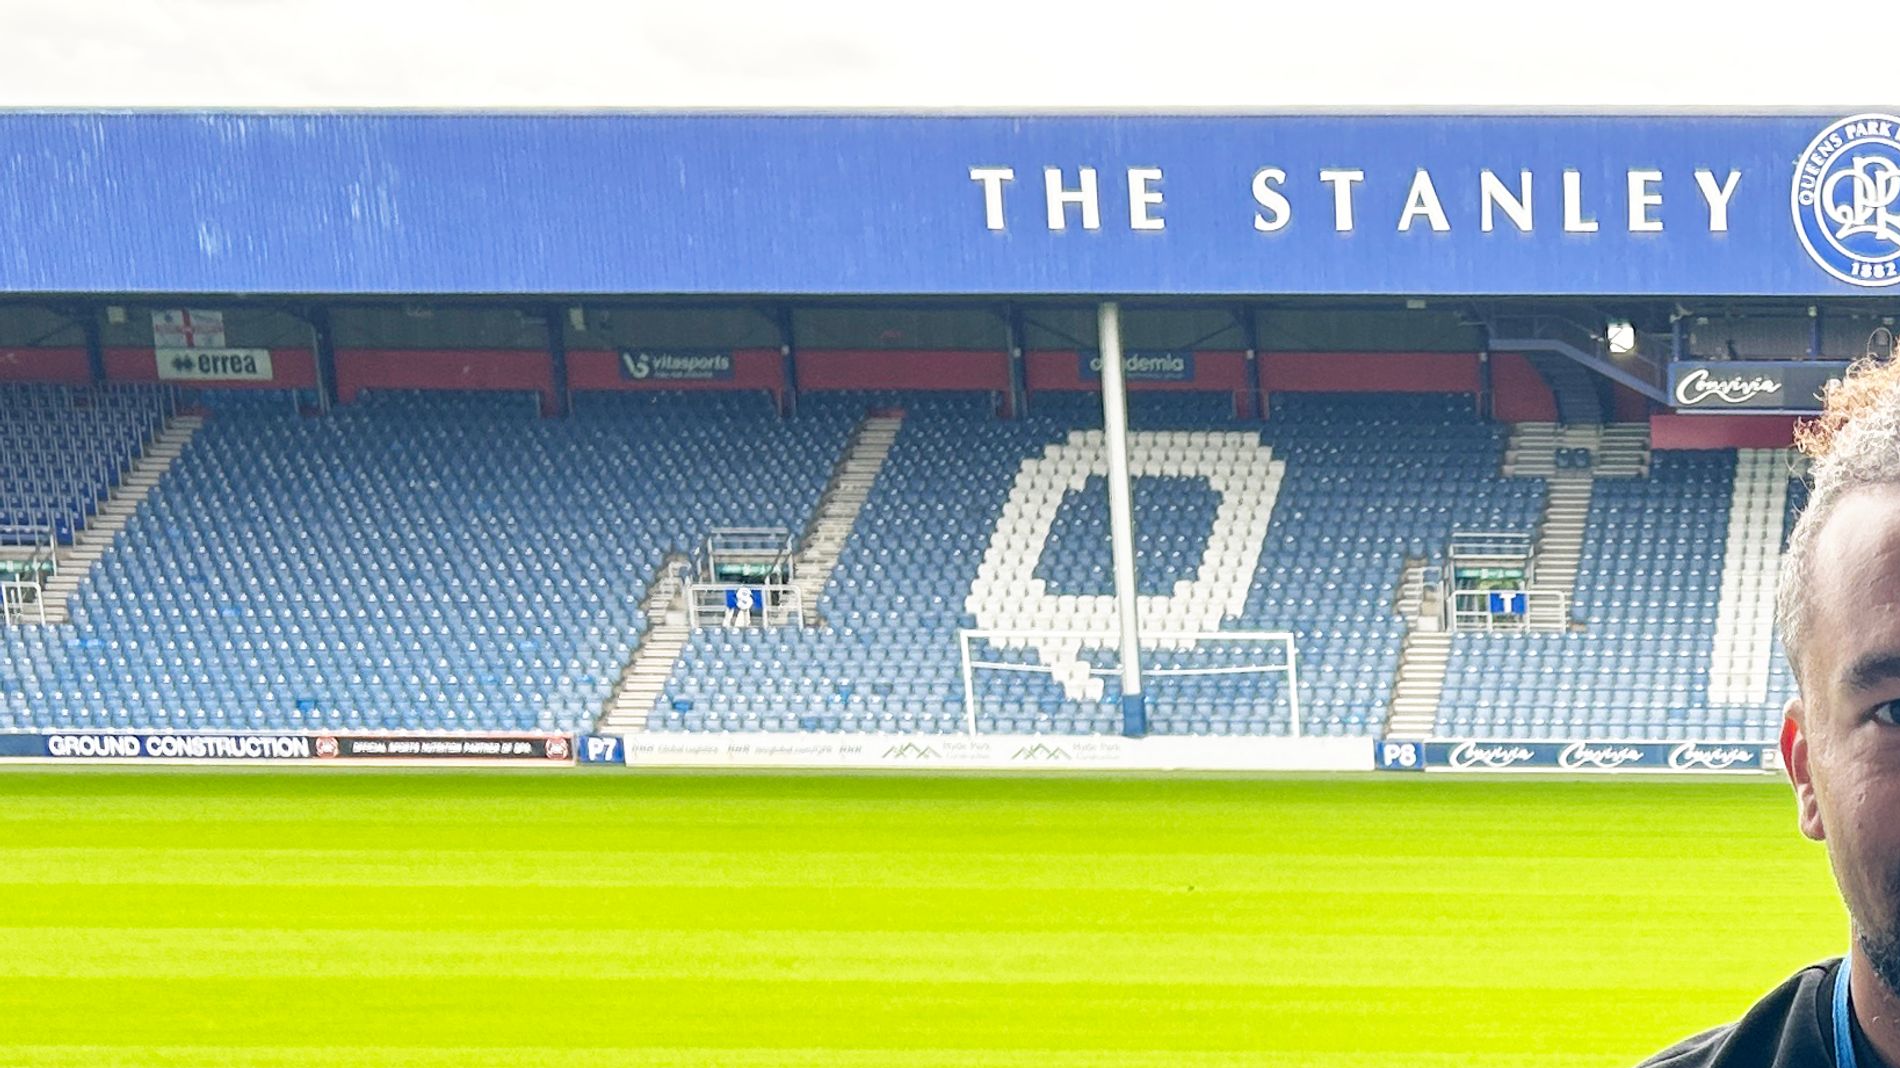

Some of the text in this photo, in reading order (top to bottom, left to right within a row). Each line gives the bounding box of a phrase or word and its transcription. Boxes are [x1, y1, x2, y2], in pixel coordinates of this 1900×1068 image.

[1799, 133, 1843, 206] QUEENS
[1844, 120, 1892, 139] PARK
[969, 167, 1742, 233] THE STANLEY
[1851, 262, 1898, 279] 1882
[198, 353, 257, 374] errea
[1089, 353, 1184, 371] ademia
[1499, 593, 1516, 612] T
[48, 734, 309, 758] GROUND CONSTRUCTION
[588, 738, 617, 761] P7
[1384, 743, 1417, 766] P8
